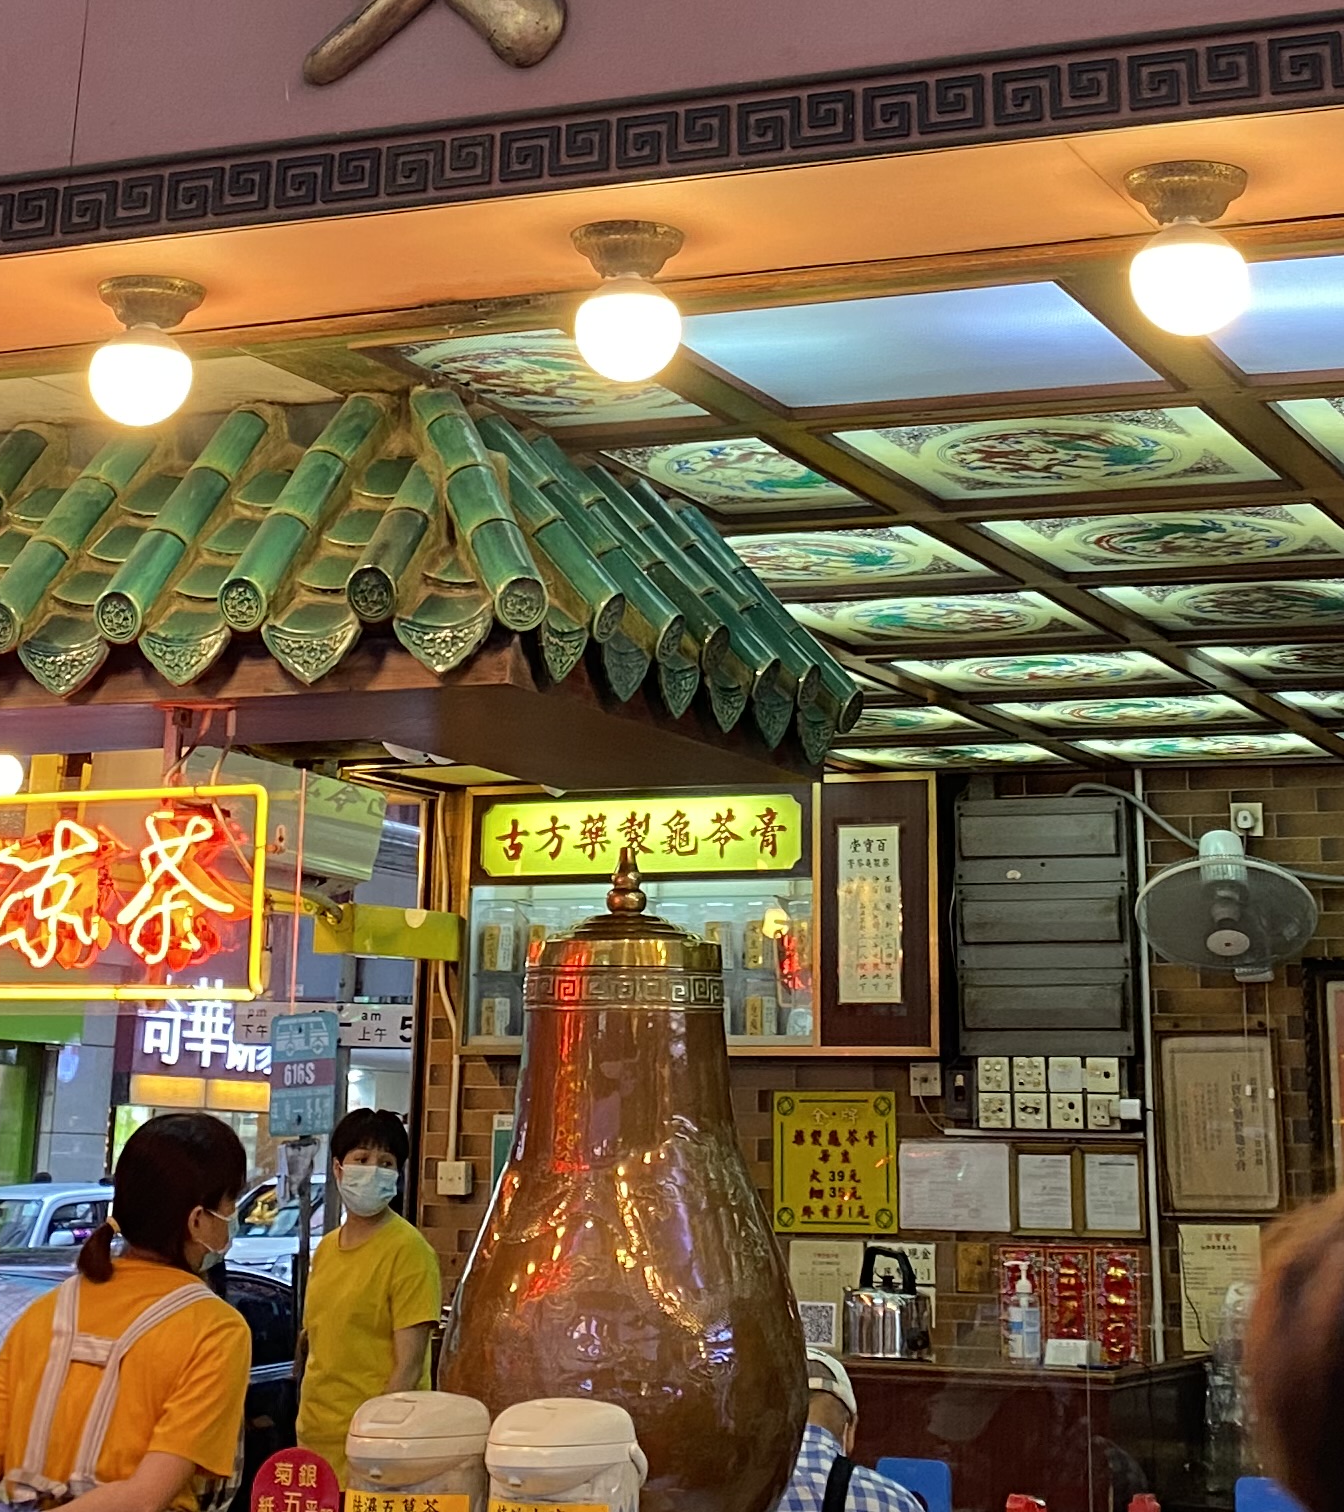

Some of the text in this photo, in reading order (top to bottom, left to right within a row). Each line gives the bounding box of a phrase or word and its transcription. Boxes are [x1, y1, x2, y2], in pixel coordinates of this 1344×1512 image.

[247, 1007, 268, 1020] pm
[361, 1011, 382, 1021] am
[242, 1023, 268, 1039] 下午
[358, 1026, 387, 1042] 上午
[283, 1061, 316, 1087] 616S
